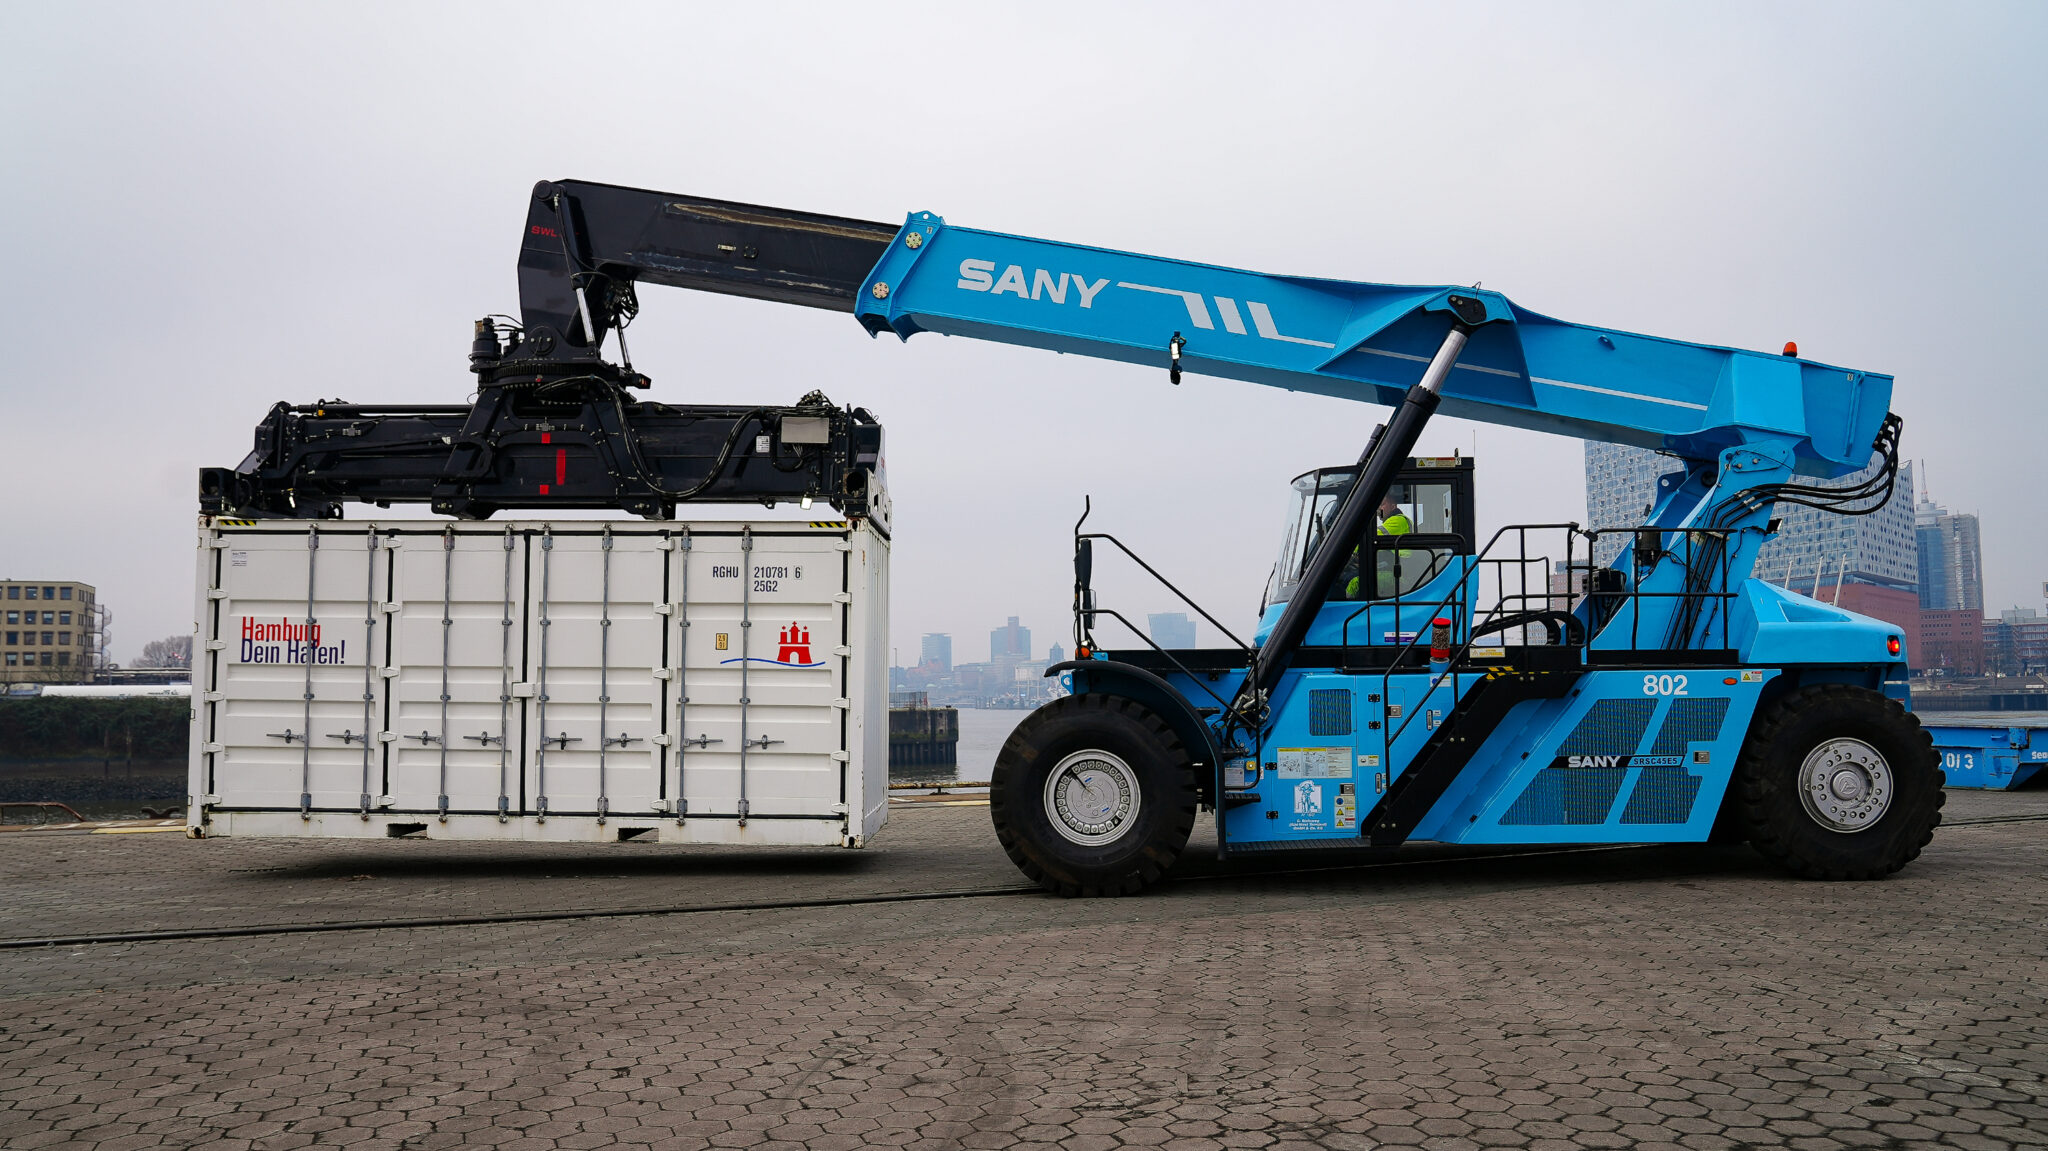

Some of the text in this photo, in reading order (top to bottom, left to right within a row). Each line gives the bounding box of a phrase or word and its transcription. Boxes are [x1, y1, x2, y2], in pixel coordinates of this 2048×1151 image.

[531, 225, 557, 237] SWL
[957, 258, 1111, 309] SANY
[712, 566, 801, 579] RGHU 210781 6
[754, 580, 778, 592] 25G2
[242, 616, 321, 648] Hamburg
[241, 638, 345, 664] Dein Hafen!
[1642, 674, 1688, 696] 802
[1568, 755, 1621, 768] SANY
